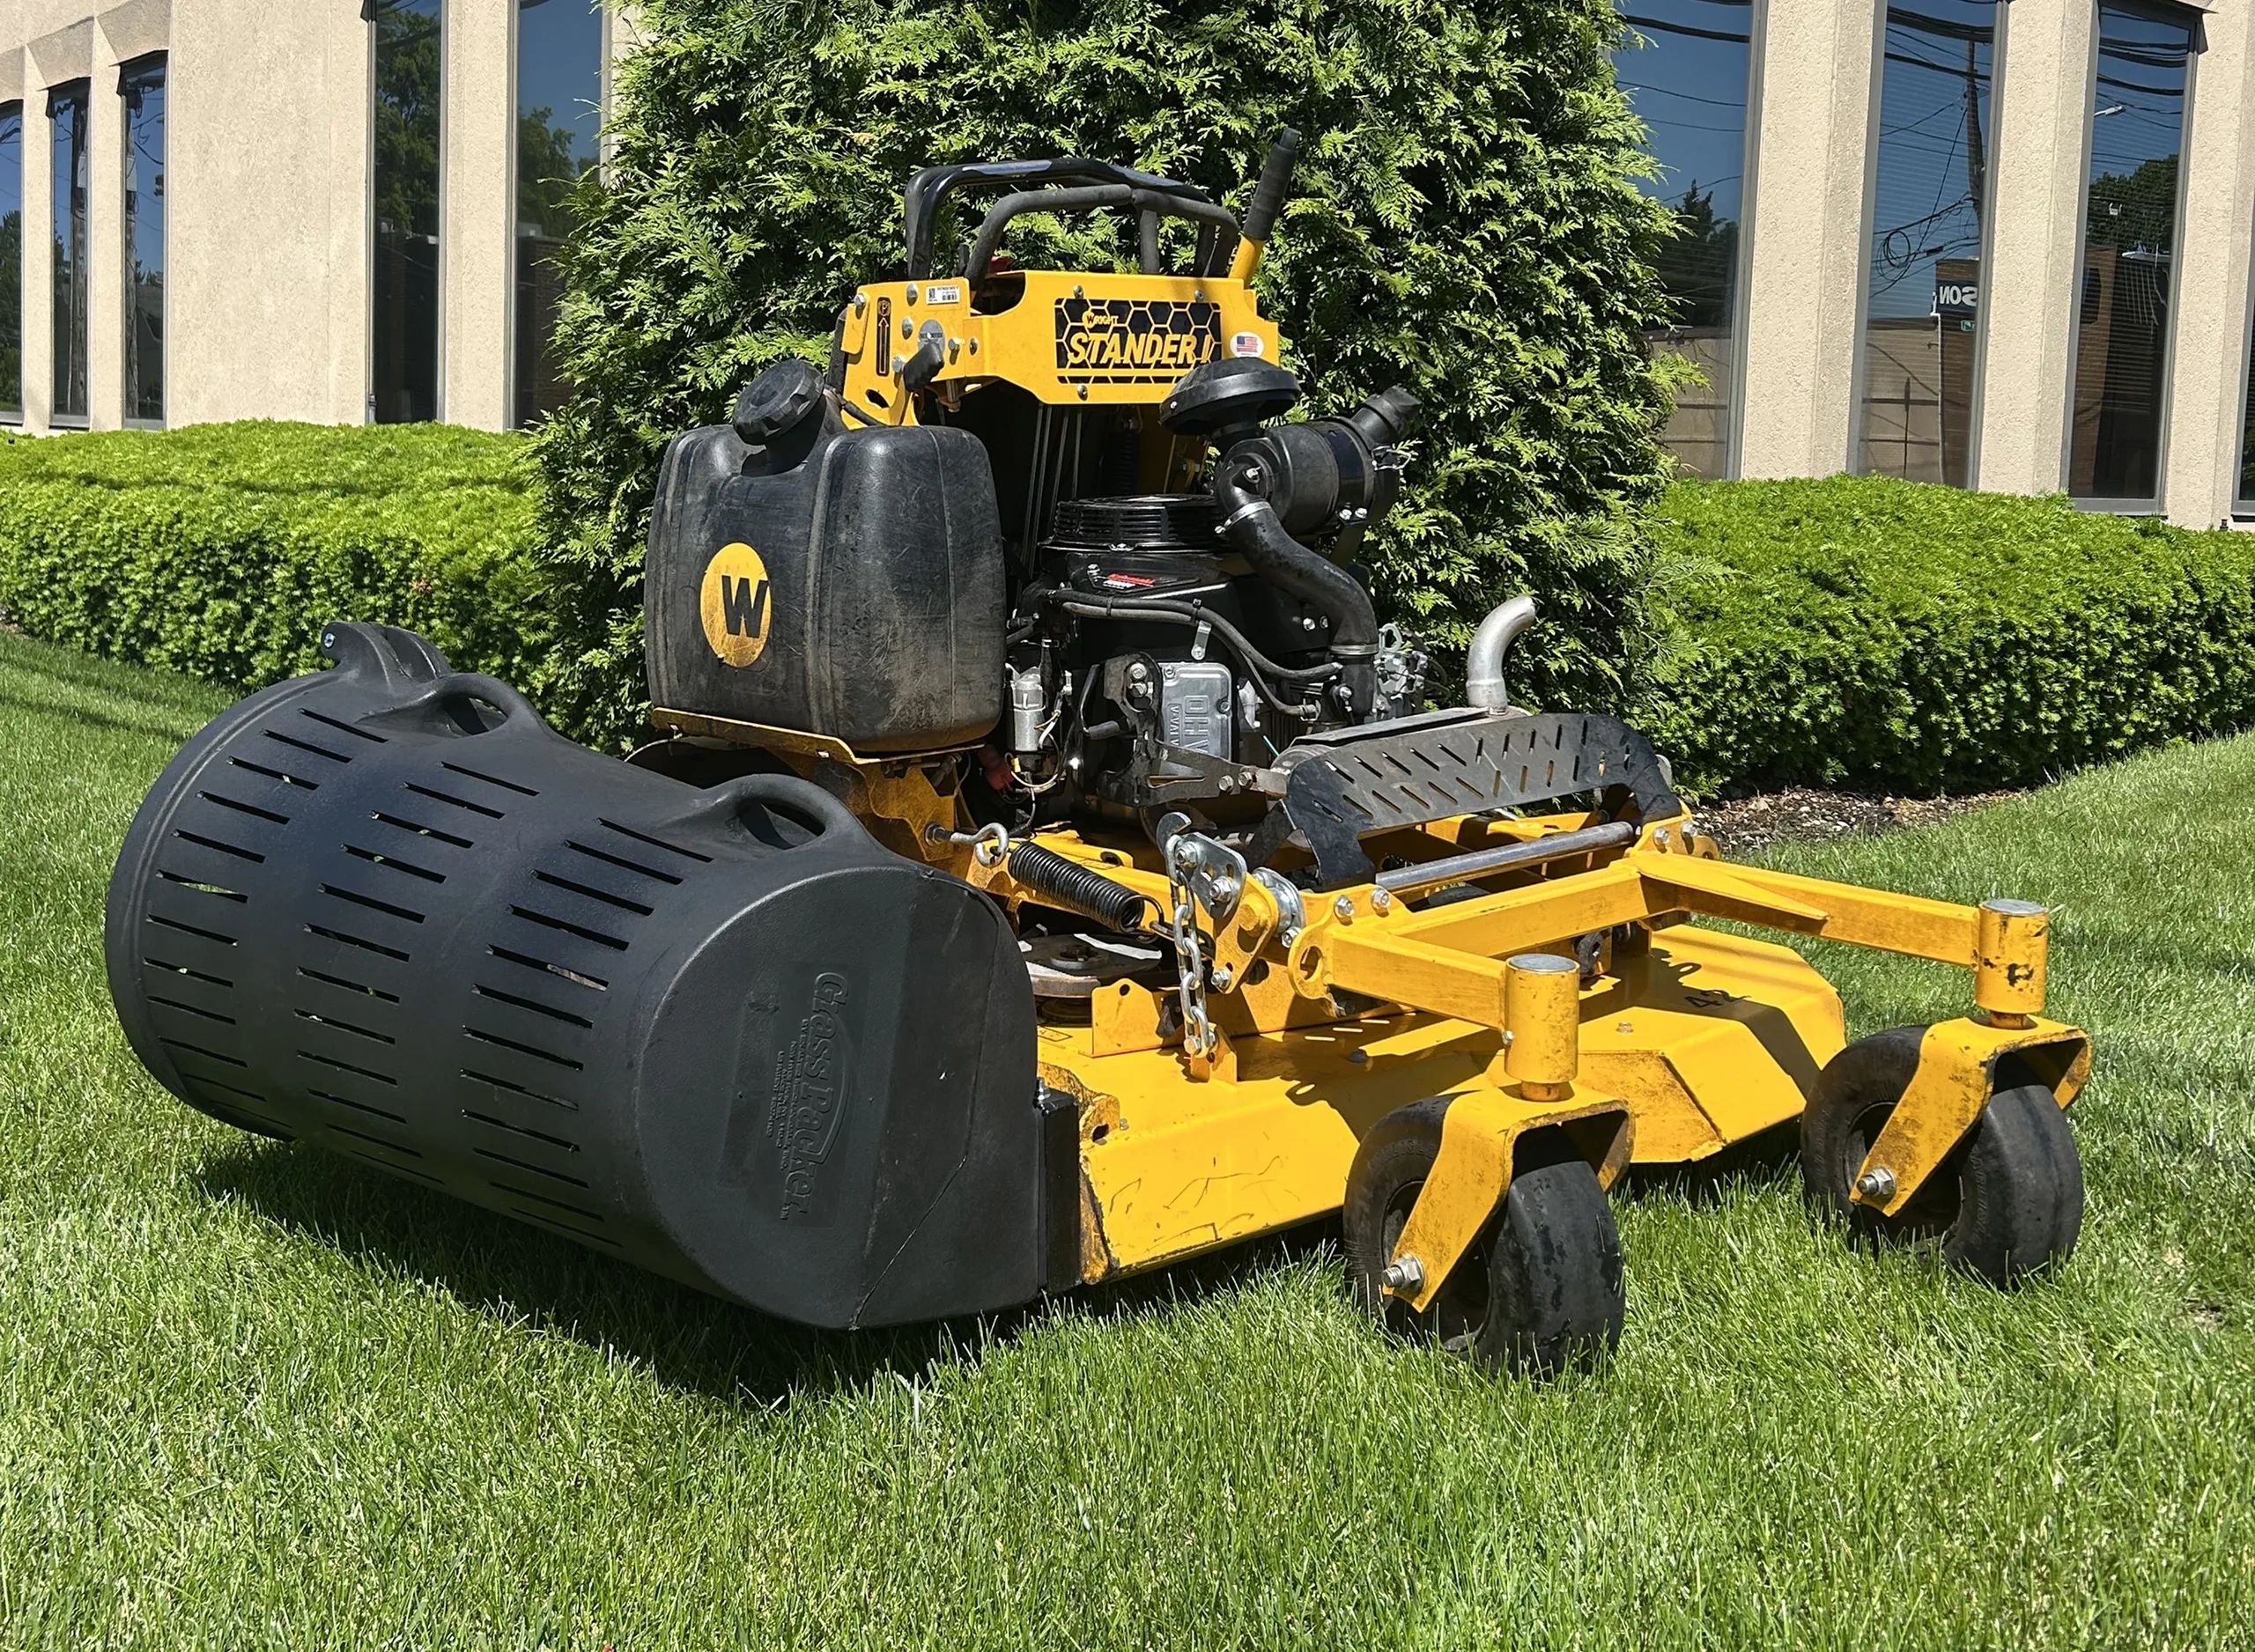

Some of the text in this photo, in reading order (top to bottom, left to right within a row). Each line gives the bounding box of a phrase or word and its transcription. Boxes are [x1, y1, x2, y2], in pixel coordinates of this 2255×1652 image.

[1067, 332, 1198, 365] STANDER
[721, 574, 769, 639] W
[805, 971, 849, 1081] Grass
[783, 1081, 835, 1214] Packer
